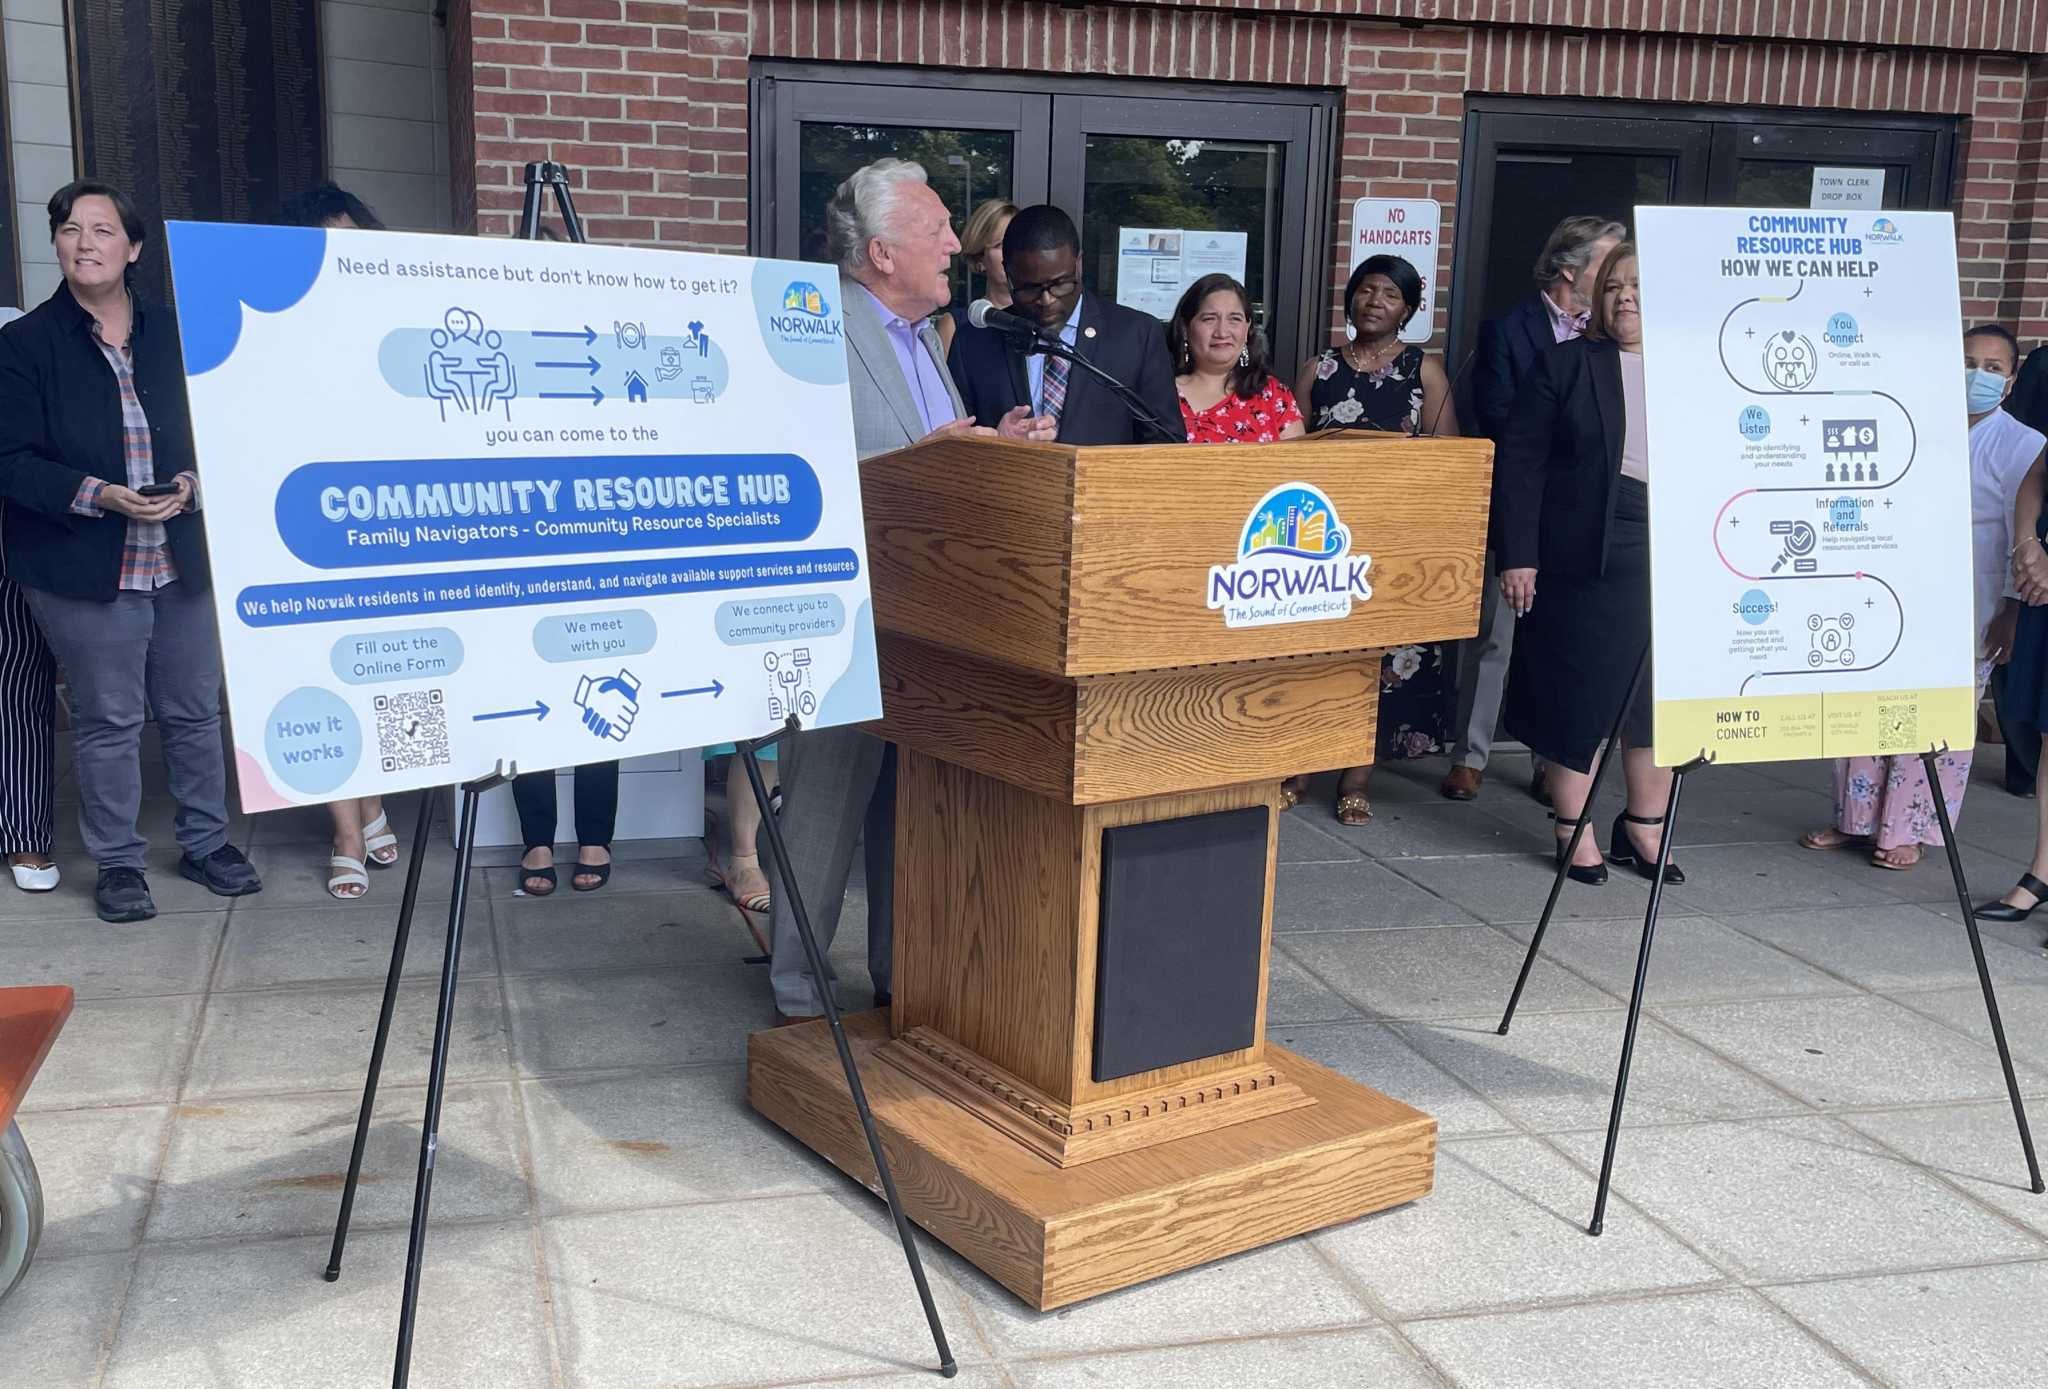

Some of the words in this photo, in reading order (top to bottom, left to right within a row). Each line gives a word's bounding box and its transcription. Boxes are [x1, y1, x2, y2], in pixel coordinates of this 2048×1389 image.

[1820, 178, 1843, 186] TOWN
[1847, 178, 1870, 186] CLERK
[1388, 208, 1406, 223] NO
[1749, 215, 1848, 235] COMMUNITY
[1359, 229, 1432, 246] HANDCARTS
[1737, 236, 1825, 255] RESOURCE
[1829, 238, 1863, 255] HUB
[337, 257, 390, 276] Need
[396, 261, 499, 280] assistance
[503, 264, 535, 282] but
[540, 267, 582, 285] don't
[587, 270, 629, 288] know
[633, 273, 665, 290] how
[670, 277, 687, 291] to
[691, 279, 717, 296] get
[719, 279, 738, 295] it?
[1721, 259, 1761, 277] HOW
[1765, 260, 1793, 277] WE
[1797, 260, 1833, 278] CAN
[1837, 261, 1879, 279] HELP
[770, 316, 842, 338] NORWALK
[1833, 318, 1852, 330] You
[1823, 332, 1864, 343] Connect
[1746, 409, 1763, 419] We
[486, 427, 518, 446] you
[523, 427, 554, 442] can
[560, 427, 604, 441] come
[610, 427, 628, 441] to
[632, 425, 659, 441] the
[1739, 423, 1771, 434] Listen
[320, 479, 562, 522] COMMUNITY
[573, 475, 731, 512] RESOURCE
[737, 474, 792, 505] HUB
[1816, 496, 1874, 509] Information
[1836, 509, 1855, 520] and
[347, 526, 411, 547] Family
[416, 521, 519, 545] Navigators
[535, 516, 628, 537] Community
[633, 513, 704, 532] Resource
[706, 510, 781, 529] Specialists
[1823, 521, 1869, 533] Referrals
[243, 601, 268, 616] We
[272, 598, 302, 615] help
[359, 590, 419, 608] residents
[423, 588, 436, 602] in
[440, 586, 471, 600] need
[475, 582, 525, 598] identify,
[528, 576, 596, 594] understand,
[599, 574, 620, 589] and
[623, 572, 668, 588] navigate
[671, 568, 716, 583] available
[718, 566, 754, 581] support
[756, 563, 794, 577] services
[796, 562, 812, 574] and
[1212, 561, 1368, 602] NORWALK
[732, 605, 750, 617] We
[753, 602, 794, 615] connect
[797, 602, 815, 614] you
[818, 599, 829, 610] to
[1229, 607, 1247, 621] The
[1249, 602, 1277, 621] Sound
[1277, 603, 1288, 617] of
[1289, 599, 1348, 617] Connecticut
[1732, 601, 1778, 614] Success!
[564, 621, 588, 634] We
[590, 618, 624, 632] meet
[728, 623, 786, 638] community
[788, 618, 836, 633] providers
[355, 640, 377, 656] Fill
[382, 639, 408, 653] out
[413, 636, 439, 650] the
[571, 639, 600, 653] with
[603, 637, 627, 654] you
[353, 659, 402, 677] Online
[407, 656, 447, 672] Form
[1716, 711, 1742, 723] HOW
[1745, 710, 1760, 722] TO
[276, 721, 321, 739] How
[327, 716, 343, 732] it
[1716, 726, 1768, 740] CONNECT
[282, 743, 345, 765] works
